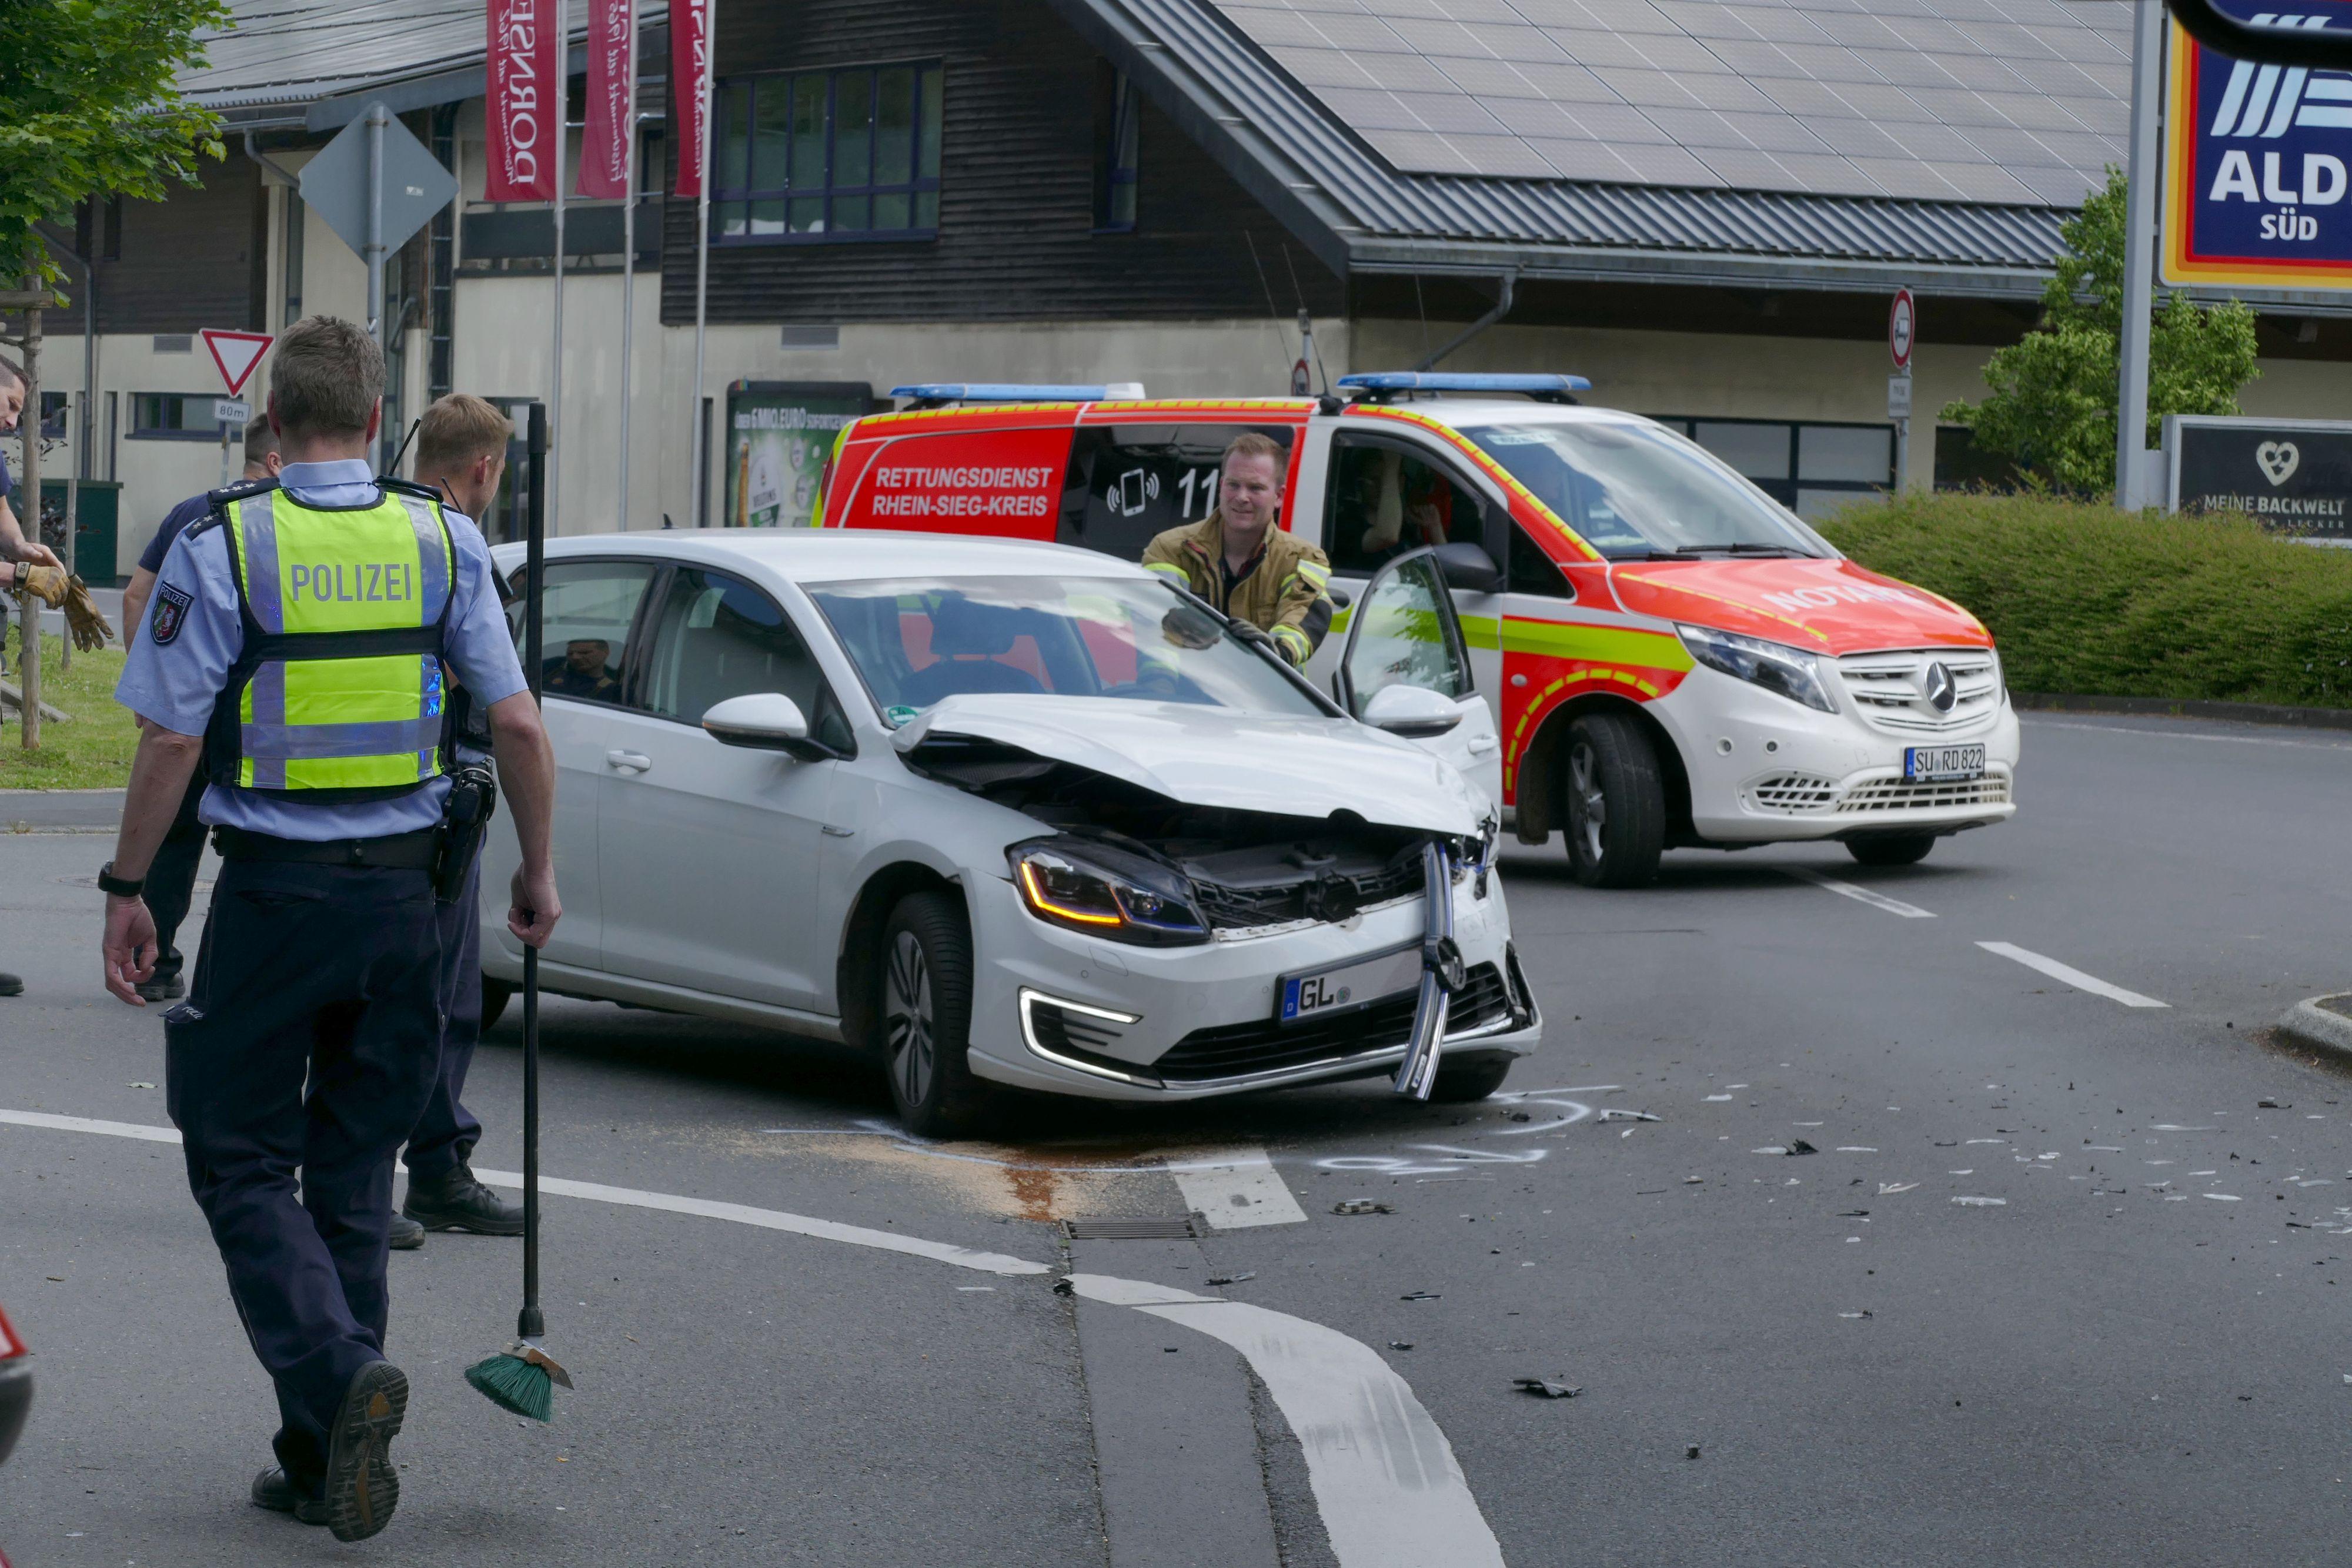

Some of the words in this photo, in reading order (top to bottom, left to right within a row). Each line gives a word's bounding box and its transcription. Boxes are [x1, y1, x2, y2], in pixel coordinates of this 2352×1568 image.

[2209, 150, 2352, 206] ALD
[2260, 206, 2318, 241] SÜD
[875, 467, 1053, 489] RETTUNGSDIENST
[871, 494, 1048, 516] RHEIN-SIEG-KREIS
[2204, 494, 2254, 511] MEINE
[2257, 497, 2346, 516] BACKWELT
[291, 563, 411, 601] POLIZEI
[160, 586, 187, 607] POLIZEI
[1916, 752, 1934, 772] SU
[1943, 750, 1959, 771] RD
[1962, 748, 1982, 770] 822
[1287, 1002, 1294, 1012] D
[1299, 977, 1334, 1010] GL
